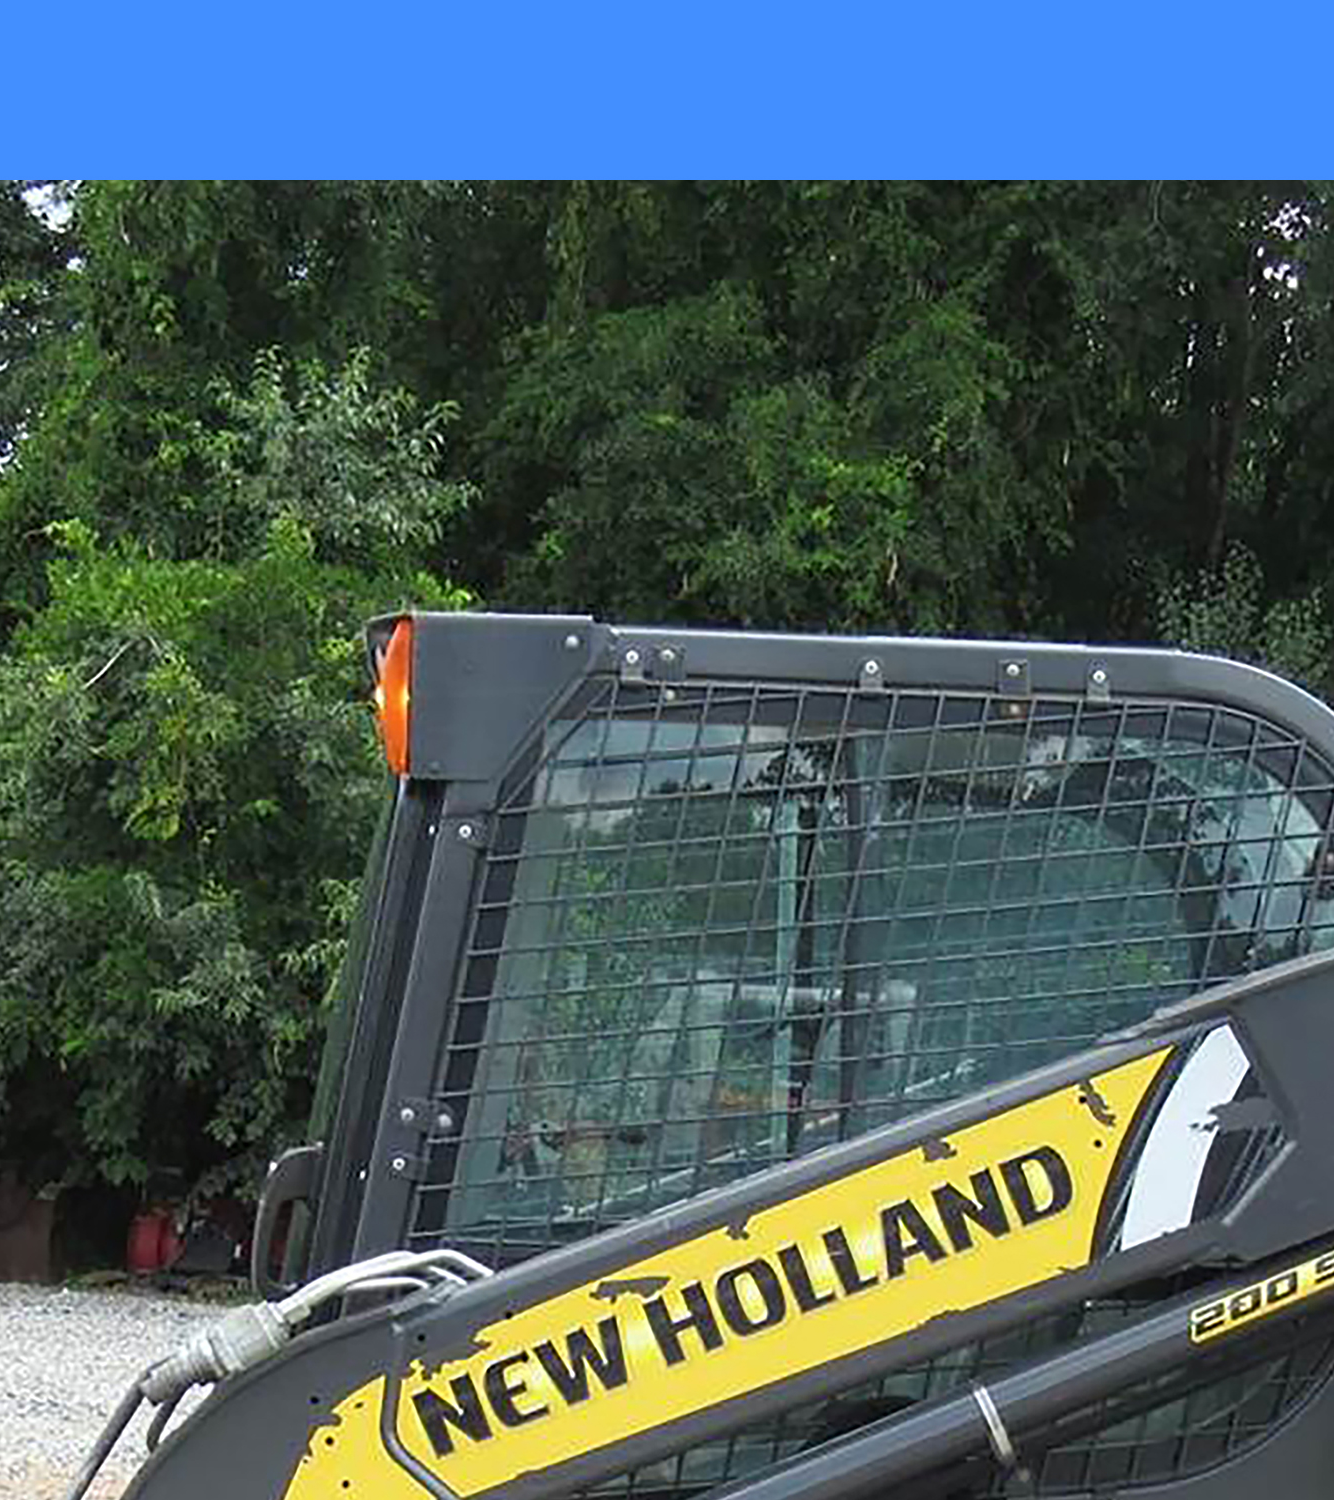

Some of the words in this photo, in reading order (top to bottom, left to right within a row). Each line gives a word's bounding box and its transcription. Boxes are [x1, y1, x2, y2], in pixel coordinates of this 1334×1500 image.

[411, 1314, 629, 1456] NEW
[641, 1143, 1072, 1366] HOLLAND
[1195, 1270, 1299, 1336] 200
